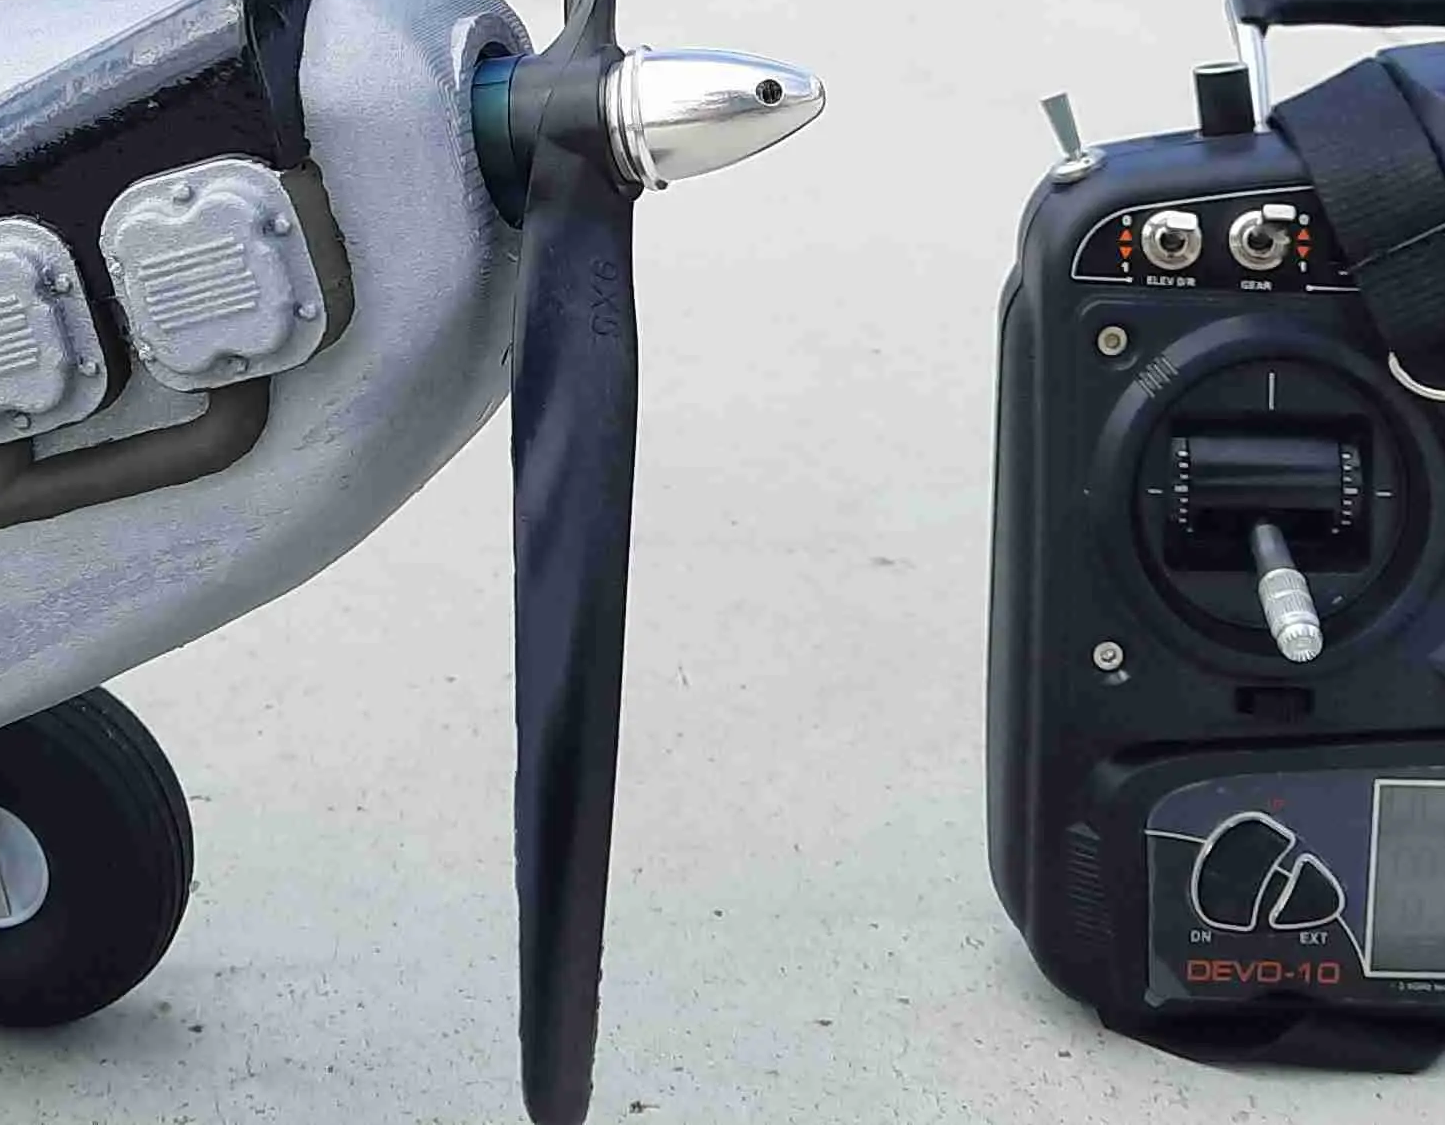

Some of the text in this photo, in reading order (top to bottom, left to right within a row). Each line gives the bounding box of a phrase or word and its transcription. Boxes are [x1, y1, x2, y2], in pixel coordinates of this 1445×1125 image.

[1240, 280, 1272, 290] GEAR
[1190, 930, 1212, 943] DN
[1299, 931, 1328, 945] EXT
[1186, 959, 1341, 984] DEVO-10
